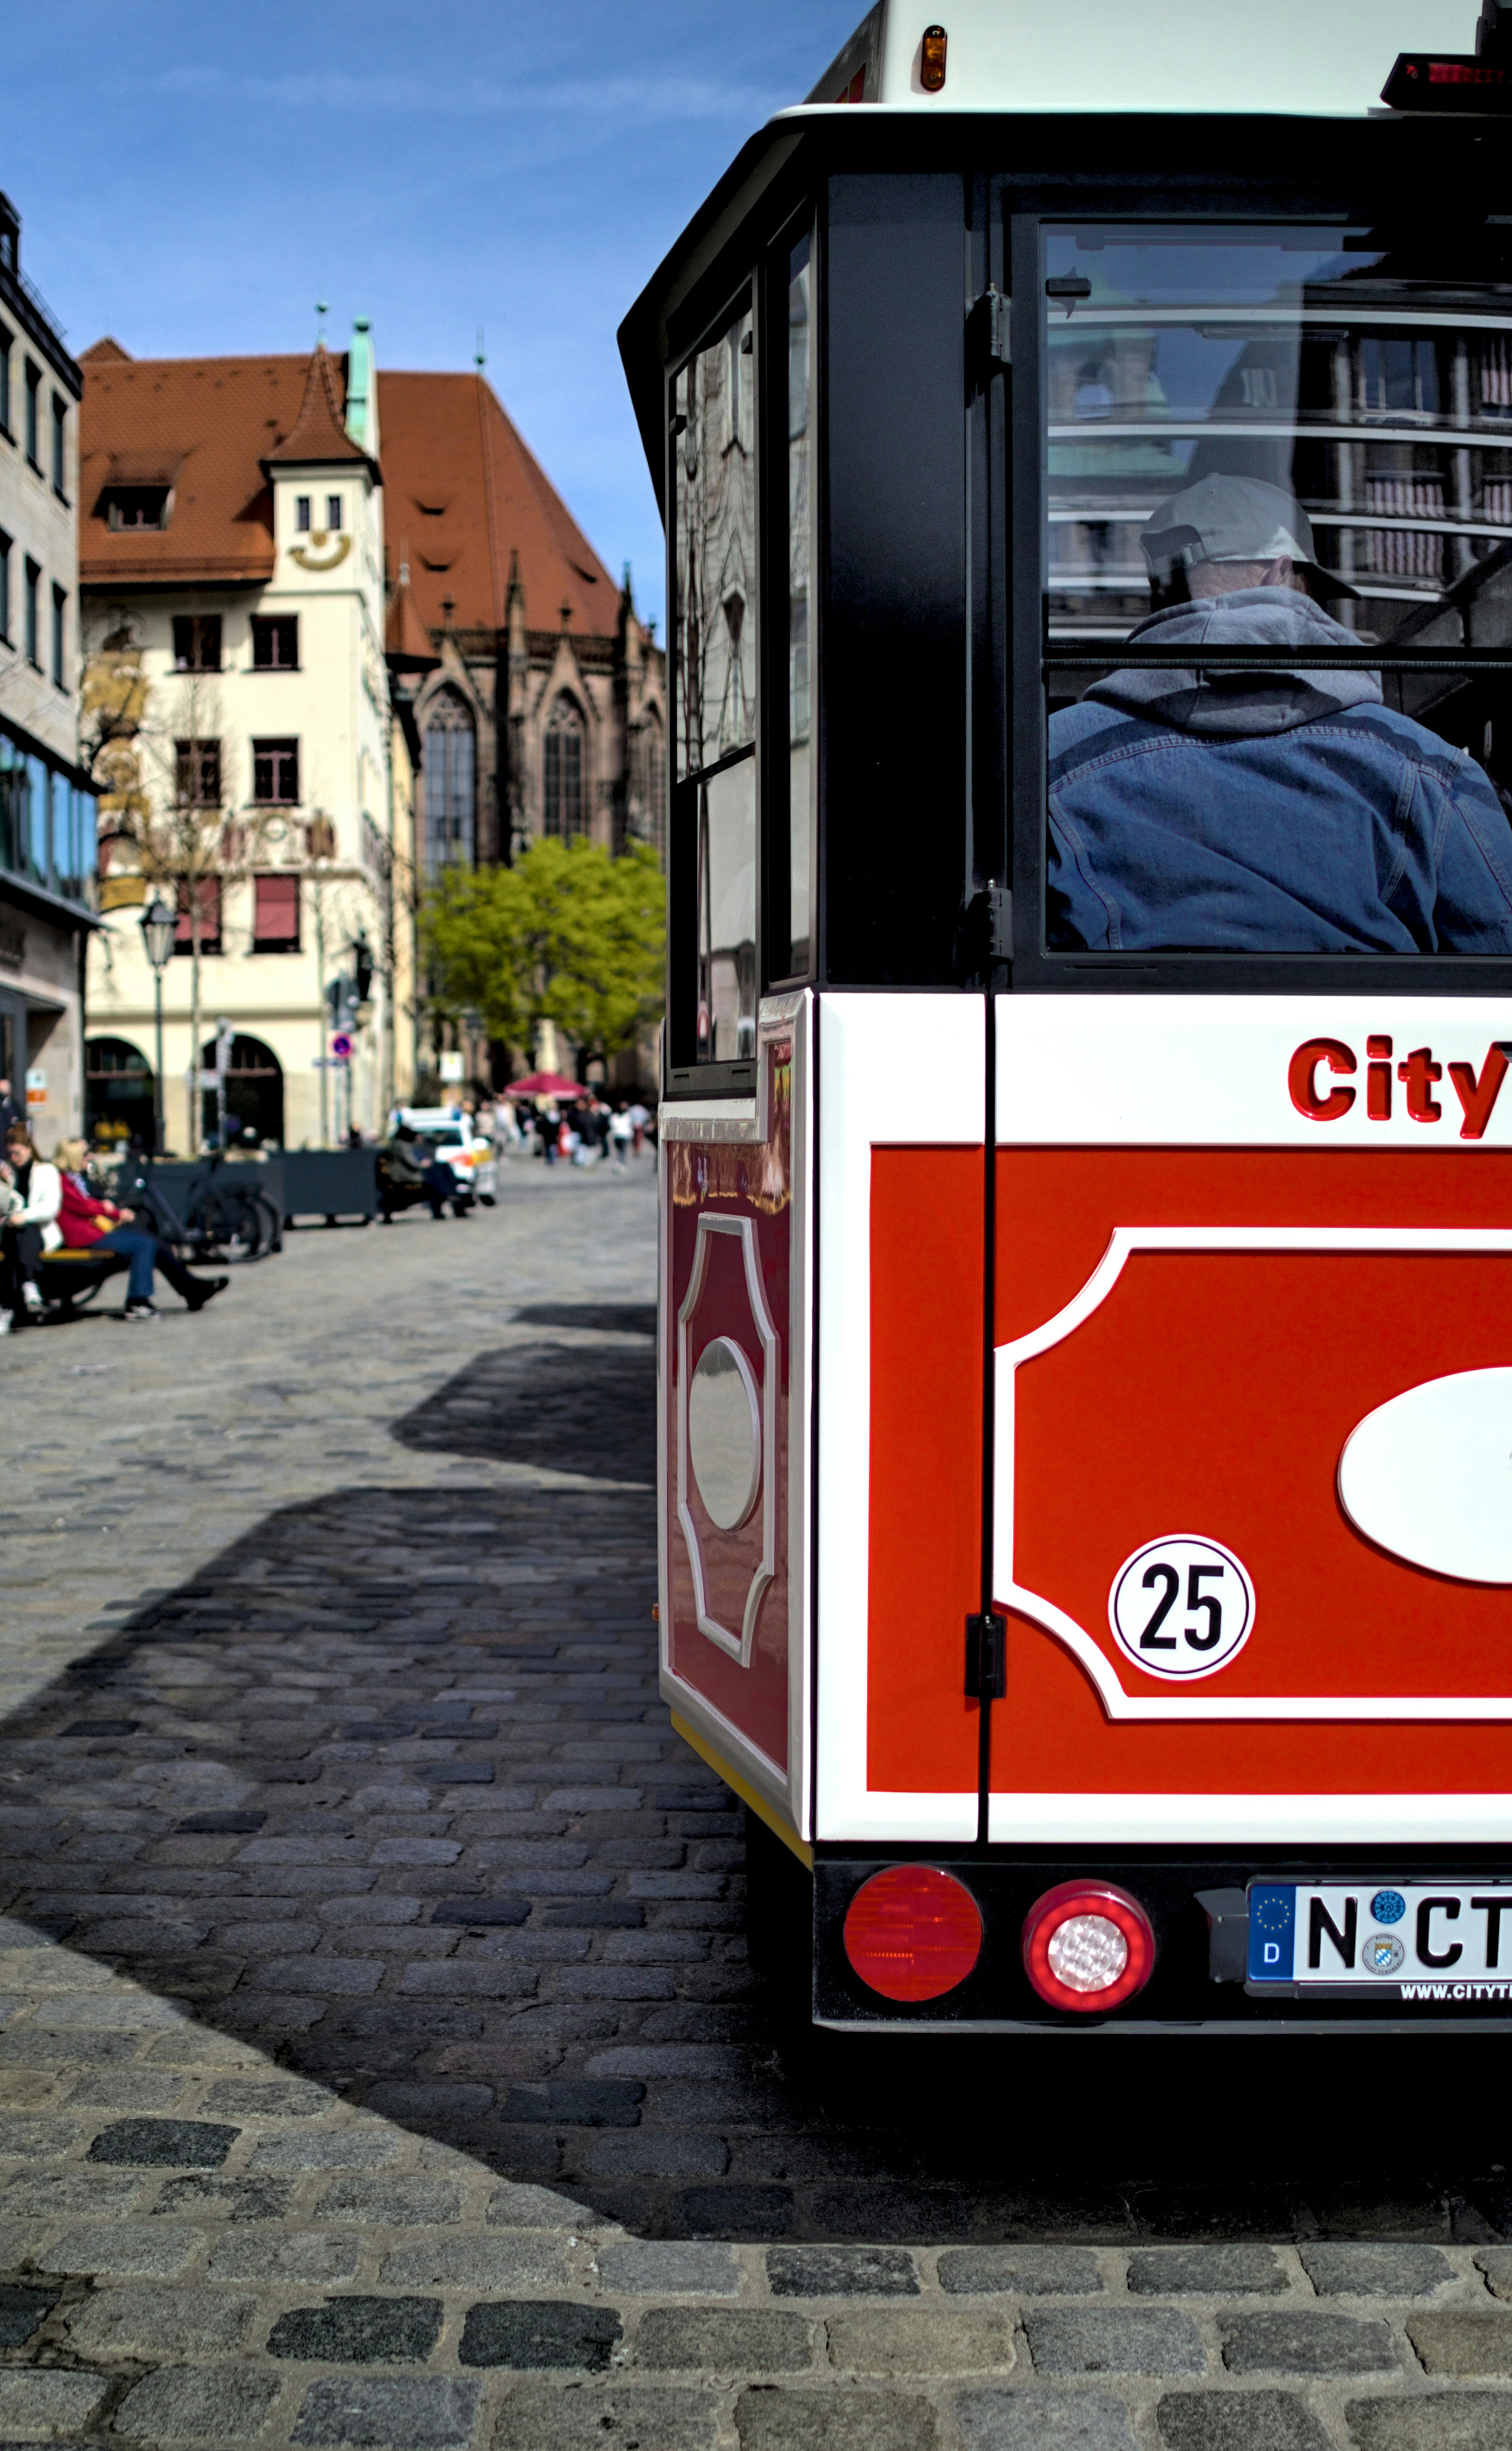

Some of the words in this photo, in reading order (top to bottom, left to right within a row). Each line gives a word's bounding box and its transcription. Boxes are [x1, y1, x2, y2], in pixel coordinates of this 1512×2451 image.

[1288, 1035, 1512, 1139] City
[1140, 1563, 1224, 1651] 25
[1264, 1943, 1280, 1963] D
[1307, 1896, 1357, 1968] N
[1416, 1896, 1512, 1969] CT
